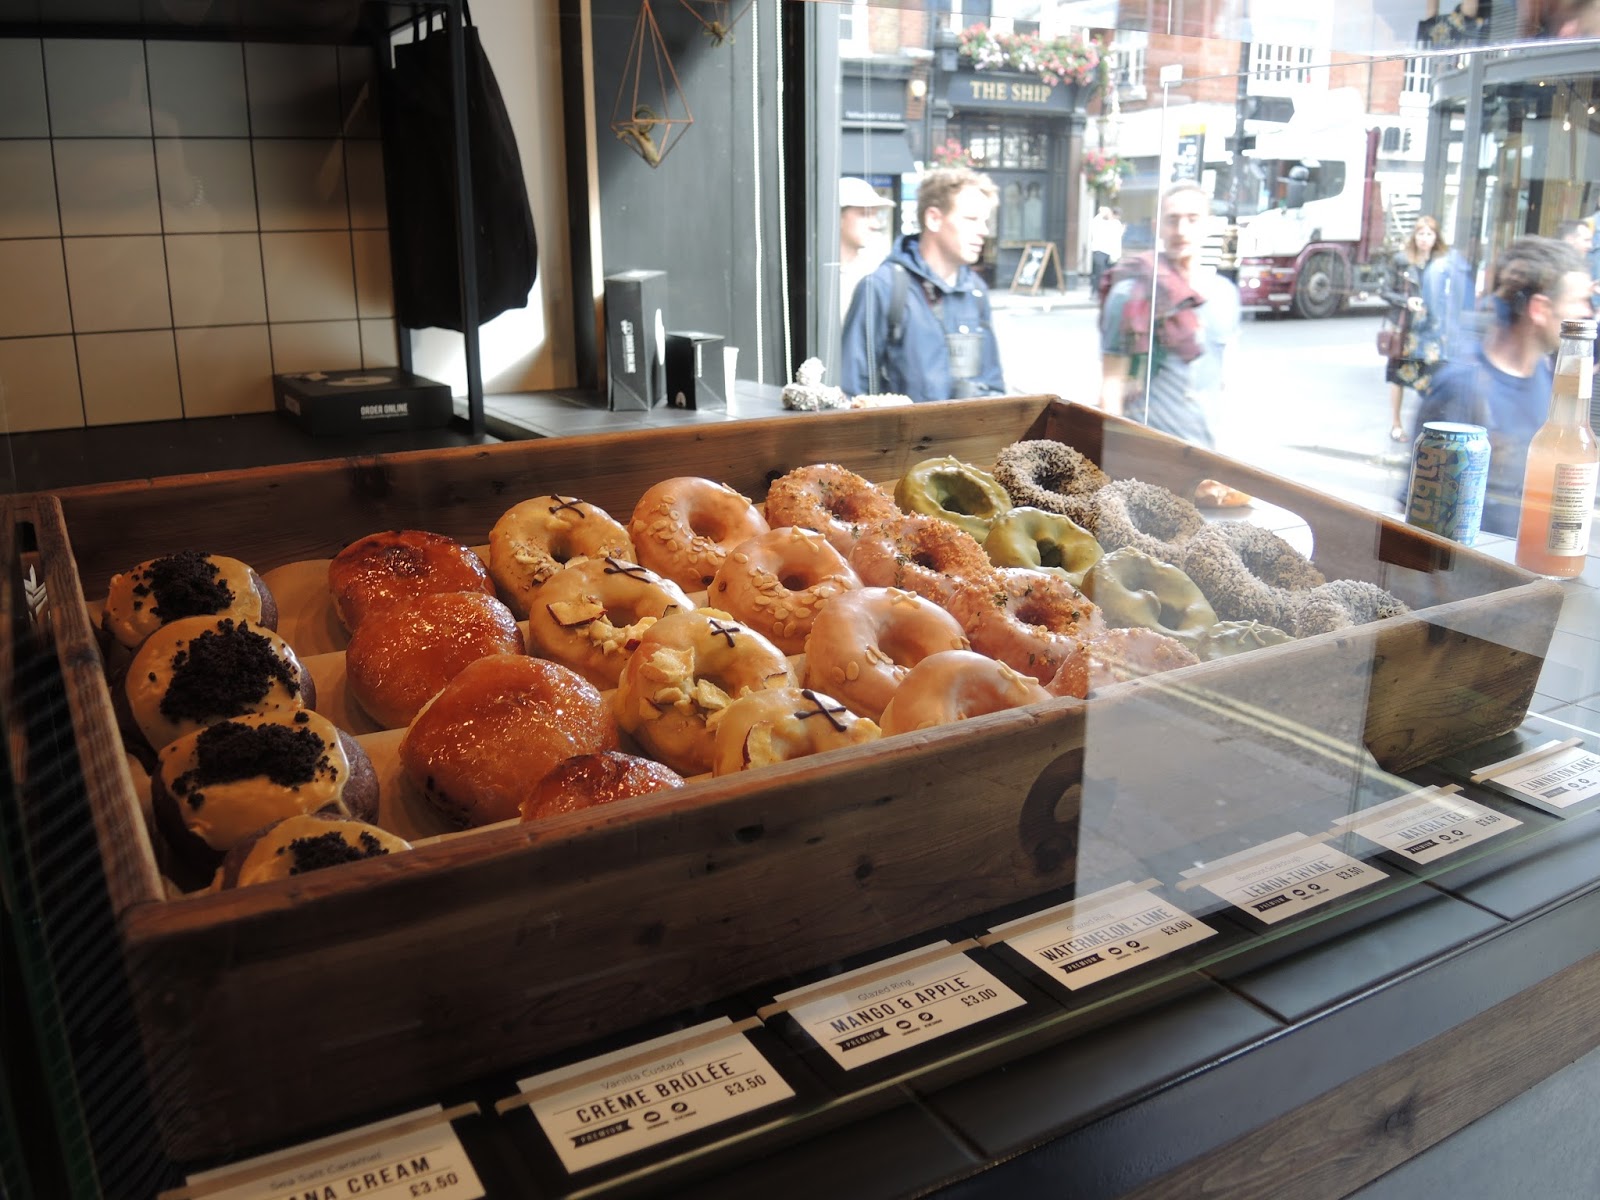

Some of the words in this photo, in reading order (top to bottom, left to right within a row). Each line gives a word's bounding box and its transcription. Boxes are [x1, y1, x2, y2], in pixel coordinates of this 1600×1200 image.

[970, 80, 1007, 100] THE
[1011, 83, 1052, 103] SHIP
[360, 404, 383, 415] ORDER
[384, 402, 408, 414] ONLINE
[1398, 819, 1447, 840] MATCHA
[1445, 811, 1469, 825] TEA
[1475, 815, 1501, 827] £3.50
[1242, 860, 1334, 898] LEMON-THYME
[1336, 866, 1365, 880] £3.50
[1066, 917, 1095, 932] Glazed
[1094, 911, 1115, 926] Ring
[1160, 920, 1193, 936] £3.00
[1039, 924, 1132, 961] WATERMELON
[1138, 908, 1174, 926] LIME
[1067, 956, 1099, 971] PREMIUM
[858, 985, 891, 1002] Glazed
[892, 978, 915, 995] Ring
[960, 988, 998, 1007] £3.00
[830, 1003, 896, 1033] MANGO
[896, 996, 914, 1011] &
[914, 976, 971, 1005] APPLE
[846, 1031, 883, 1049] PREMIUM
[601, 1072, 642, 1091] Vanilla
[641, 1058, 685, 1079] Custard
[724, 1074, 767, 1097] £3.50
[576, 1090, 651, 1123] CRÈME
[655, 1062, 735, 1098] BRÛLÉE
[580, 1124, 625, 1145] PREMIUM
[327, 1152, 382, 1175] Caramel
[347, 1156, 430, 1194] CREAM
[409, 1172, 458, 1197] £3.50
